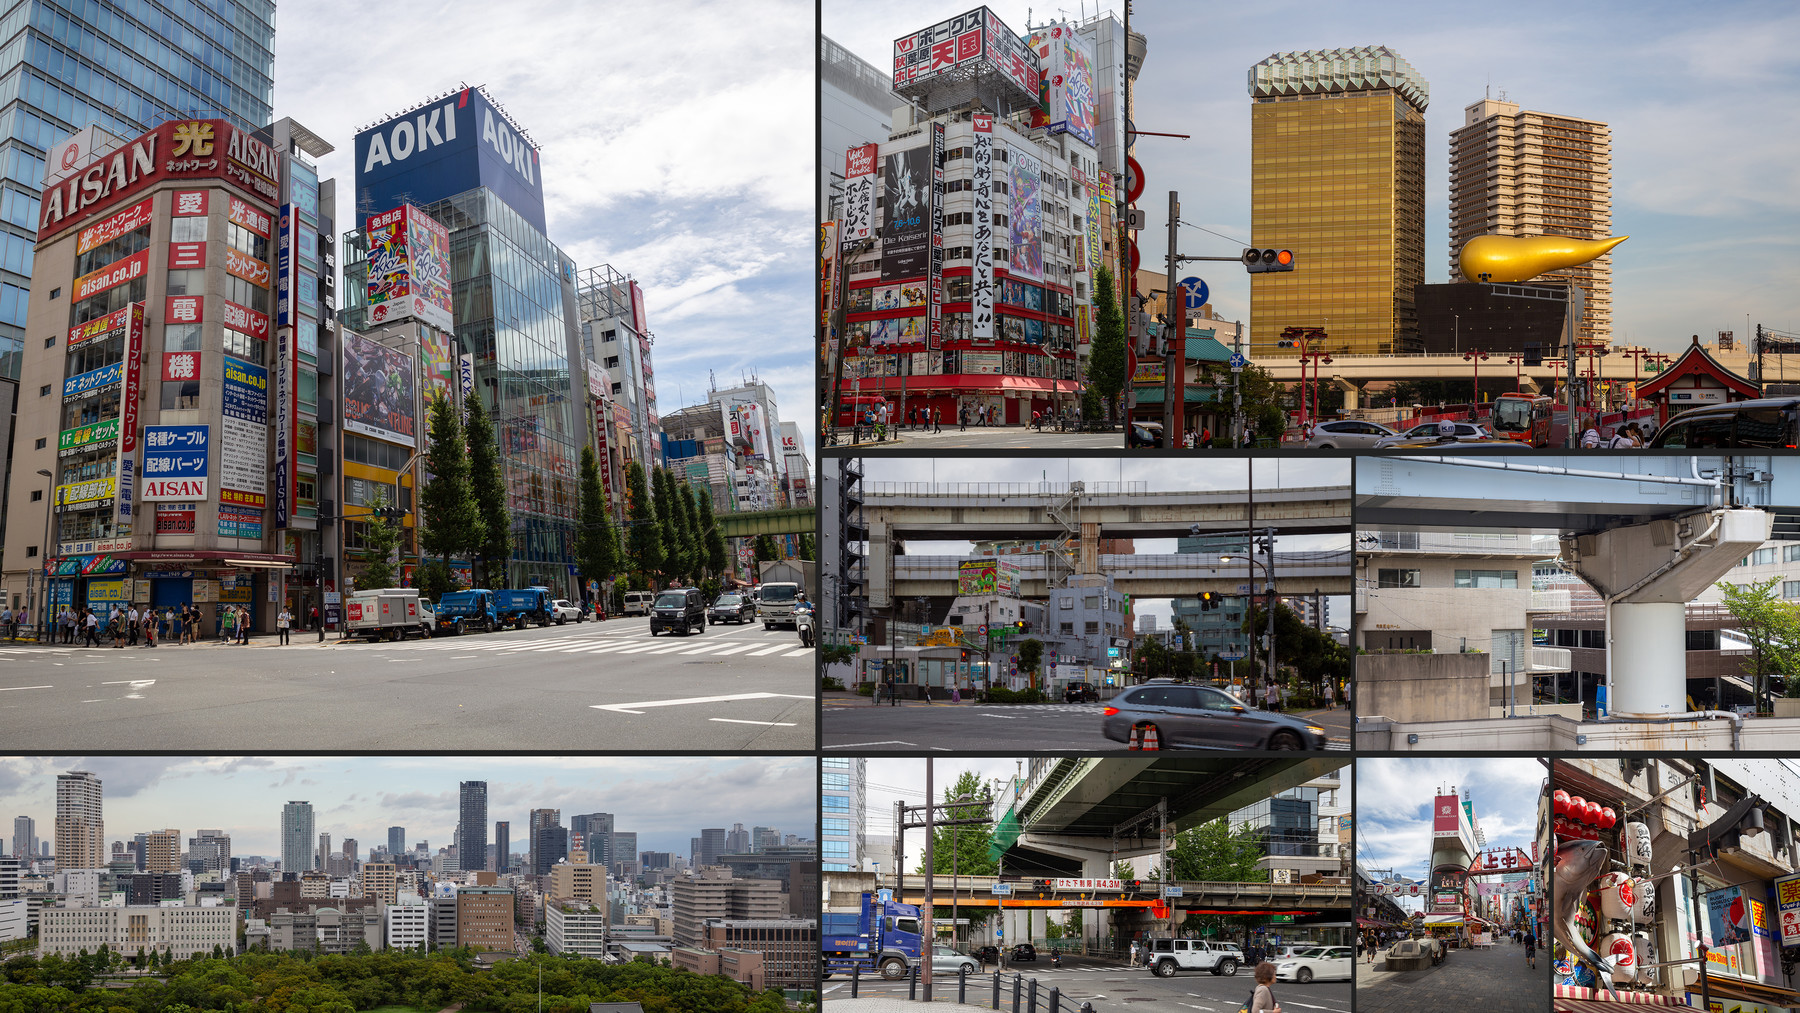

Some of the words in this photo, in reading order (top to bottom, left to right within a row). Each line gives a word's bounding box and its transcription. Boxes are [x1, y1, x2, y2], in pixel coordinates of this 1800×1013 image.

[920, 11, 981, 46] ボークス
[895, 47, 930, 69] 秋葉原
[932, 29, 980, 70] 天国
[987, 45, 1010, 69] ホビー
[1003, 25, 1038, 70] ボークス
[895, 64, 929, 83] ホビー
[1011, 52, 1039, 96] 天国
[172, 121, 214, 157] 光
[364, 102, 456, 173] AOKI
[482, 107, 535, 187] AOKI
[166, 159, 218, 172] ネットワーク
[227, 128, 279, 182] AISAN
[1010, 151, 1040, 176] FIORE
[41, 132, 157, 230] AISAN
[1088, 187, 1097, 219] TAX
[230, 200, 269, 234] 光通信
[372, 210, 402, 229] 免税店
[884, 236, 896, 245] Die
[81, 260, 141, 297] aisan.co.jp
[227, 250, 270, 284] ネットワーク
[224, 303, 268, 336] 配線パーツ
[70, 327, 81, 341] 3F
[66, 380, 77, 393] 2F
[125, 309, 143, 445] 光・ケーブル・ネットワーク
[226, 367, 266, 390] aisan.co.jp
[62, 432, 71, 446] 1F
[147, 431, 206, 447] 各種ケーブル
[146, 457, 205, 473] 配線パーツ
[120, 459, 133, 516] 愛三電機
[145, 481, 203, 497] AISAN
[277, 465, 286, 521] AISAN
[157, 520, 195, 532] aisan.co.jp
[116, 541, 131, 551] co.jp
[1483, 852, 1517, 870] 上中
[1058, 879, 1092, 888] けた下制限
[1376, 885, 1418, 894] アメ横
[1781, 881, 1800, 903] 薬
